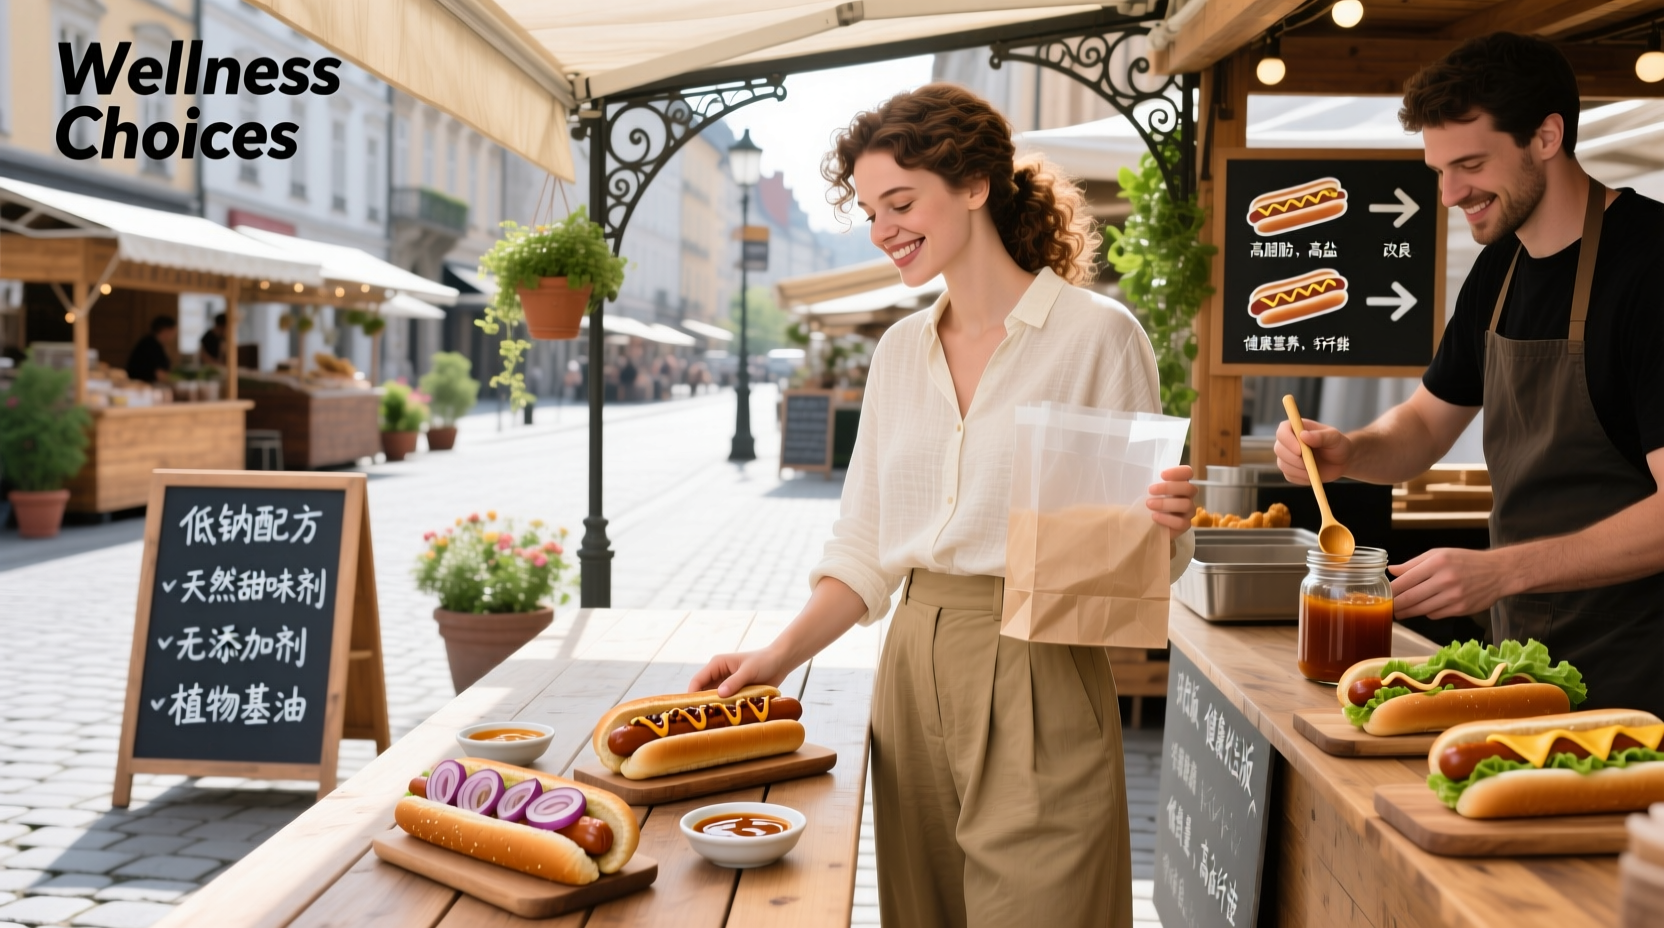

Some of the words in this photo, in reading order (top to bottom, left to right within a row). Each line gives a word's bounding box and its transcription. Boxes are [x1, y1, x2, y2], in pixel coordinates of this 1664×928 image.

[1383, 242, 1412, 259] 改良
[179, 503, 323, 547] 低钠配方
[180, 566, 327, 610] 天然甜味剂
[176, 625, 308, 668] 无添加剂
[167, 682, 307, 726] 植物基油
